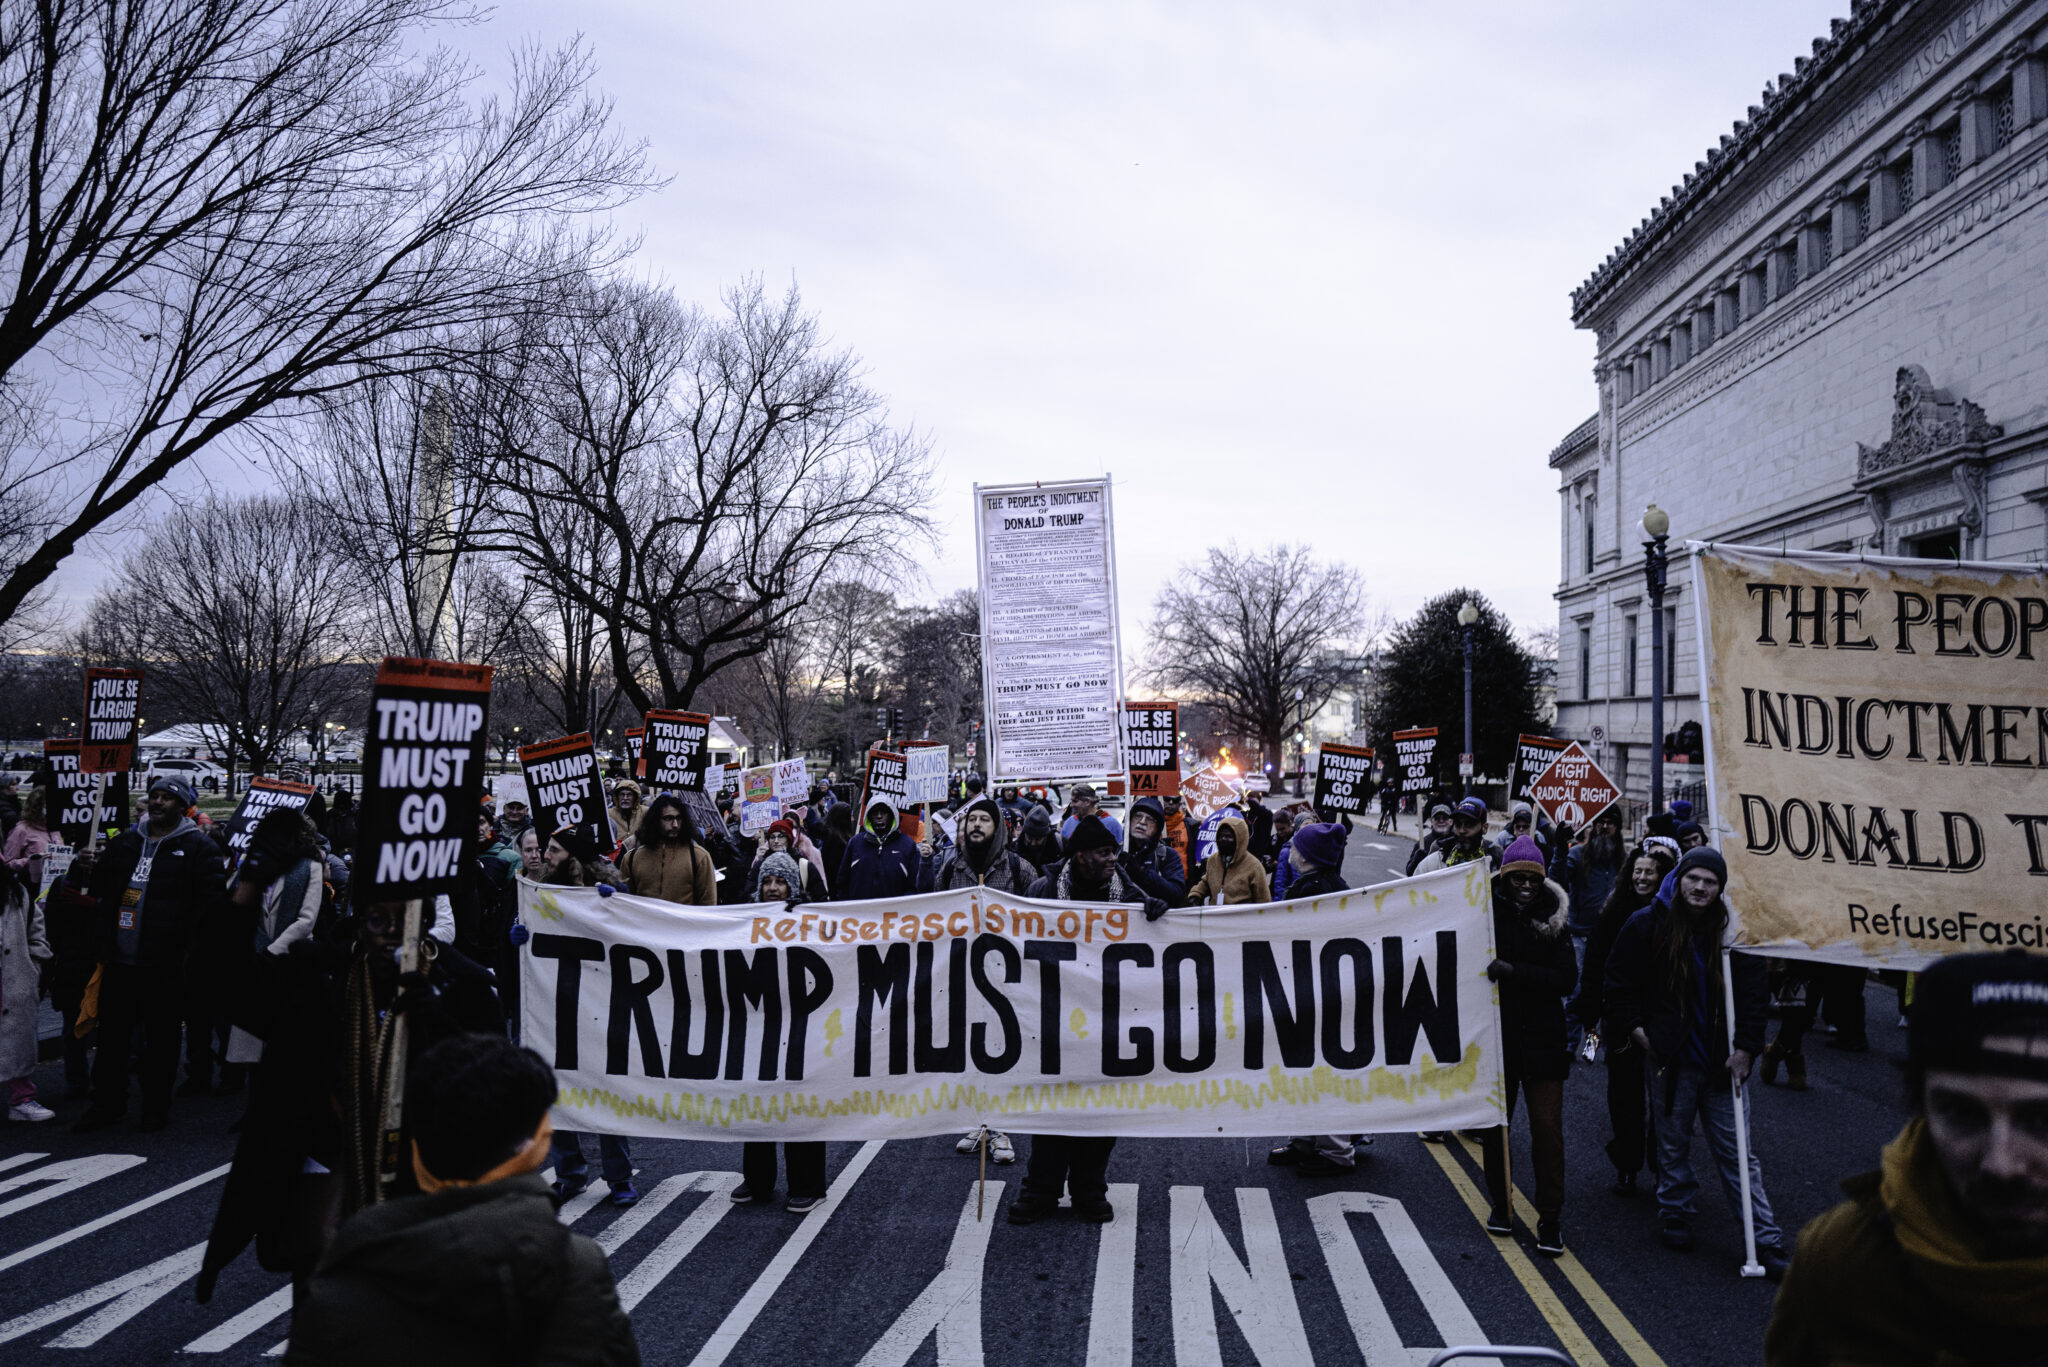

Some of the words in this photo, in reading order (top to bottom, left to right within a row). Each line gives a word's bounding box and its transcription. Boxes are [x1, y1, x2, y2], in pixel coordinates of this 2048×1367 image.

[1809, 100, 1877, 171] RAPHAEL
[1877, 1, 1988, 110] VELASQVEZ
[987, 498, 1003, 510] THE
[1008, 495, 1046, 508] PEOPLE'S
[1051, 491, 1099, 505] INDICTMENT
[1004, 517, 1044, 530] DONALD
[1050, 514, 1084, 527] TRUMP
[1745, 582, 1879, 650] THE
[92, 679, 124, 699] ¡QUE
[125, 680, 139, 698] SE
[996, 684, 1031, 693] TRUMP
[90, 701, 137, 719] LARGUE
[376, 698, 483, 742] TRUMP
[1152, 711, 1172, 728] SE
[90, 722, 132, 740] TRUMP
[653, 722, 706, 741] TRUMP
[656, 738, 700, 755] MUST
[1395, 739, 1436, 754] TRUMP
[379, 747, 471, 788] MUST
[665, 754, 689, 769] GO
[873, 759, 904, 776] ¡QUE
[907, 755, 919, 775] NO
[921, 752, 946, 774] KINGS
[1322, 754, 1370, 771] TRUMP
[1399, 752, 1433, 766] MUST
[527, 754, 593, 785] TRUMP
[1010, 763, 1104, 773] RefuseFascism.org
[1324, 767, 1364, 784] MUST
[1408, 765, 1426, 778] GO
[1555, 764, 1591, 779] FIGHT
[57, 772, 116, 789] MUST
[655, 769, 697, 786] NOW!
[1132, 774, 1158, 789] YA!
[1195, 777, 1221, 791] FIGHT
[1402, 777, 1434, 791] NOW!
[538, 778, 591, 807] MUST
[907, 777, 928, 801] SINCE
[929, 776, 946, 801] 1776
[1182, 784, 1210, 804] RADICAL
[1212, 795, 1234, 806] RIGHT
[1332, 782, 1352, 796] GO
[1536, 786, 1576, 801] RADICAL
[1580, 788, 1612, 803] RIGHT
[248, 789, 306, 809] TRUMP
[1322, 794, 1360, 810] NOW!
[399, 793, 447, 835] GO
[556, 803, 583, 827] GO
[1739, 793, 1986, 874] DONALD
[375, 838, 463, 884] NOW!
[531, 932, 834, 1082] TRUMP
[853, 932, 1077, 1077] MUST
[1101, 941, 1217, 1077] GO
[1242, 930, 1462, 1070] NOW
